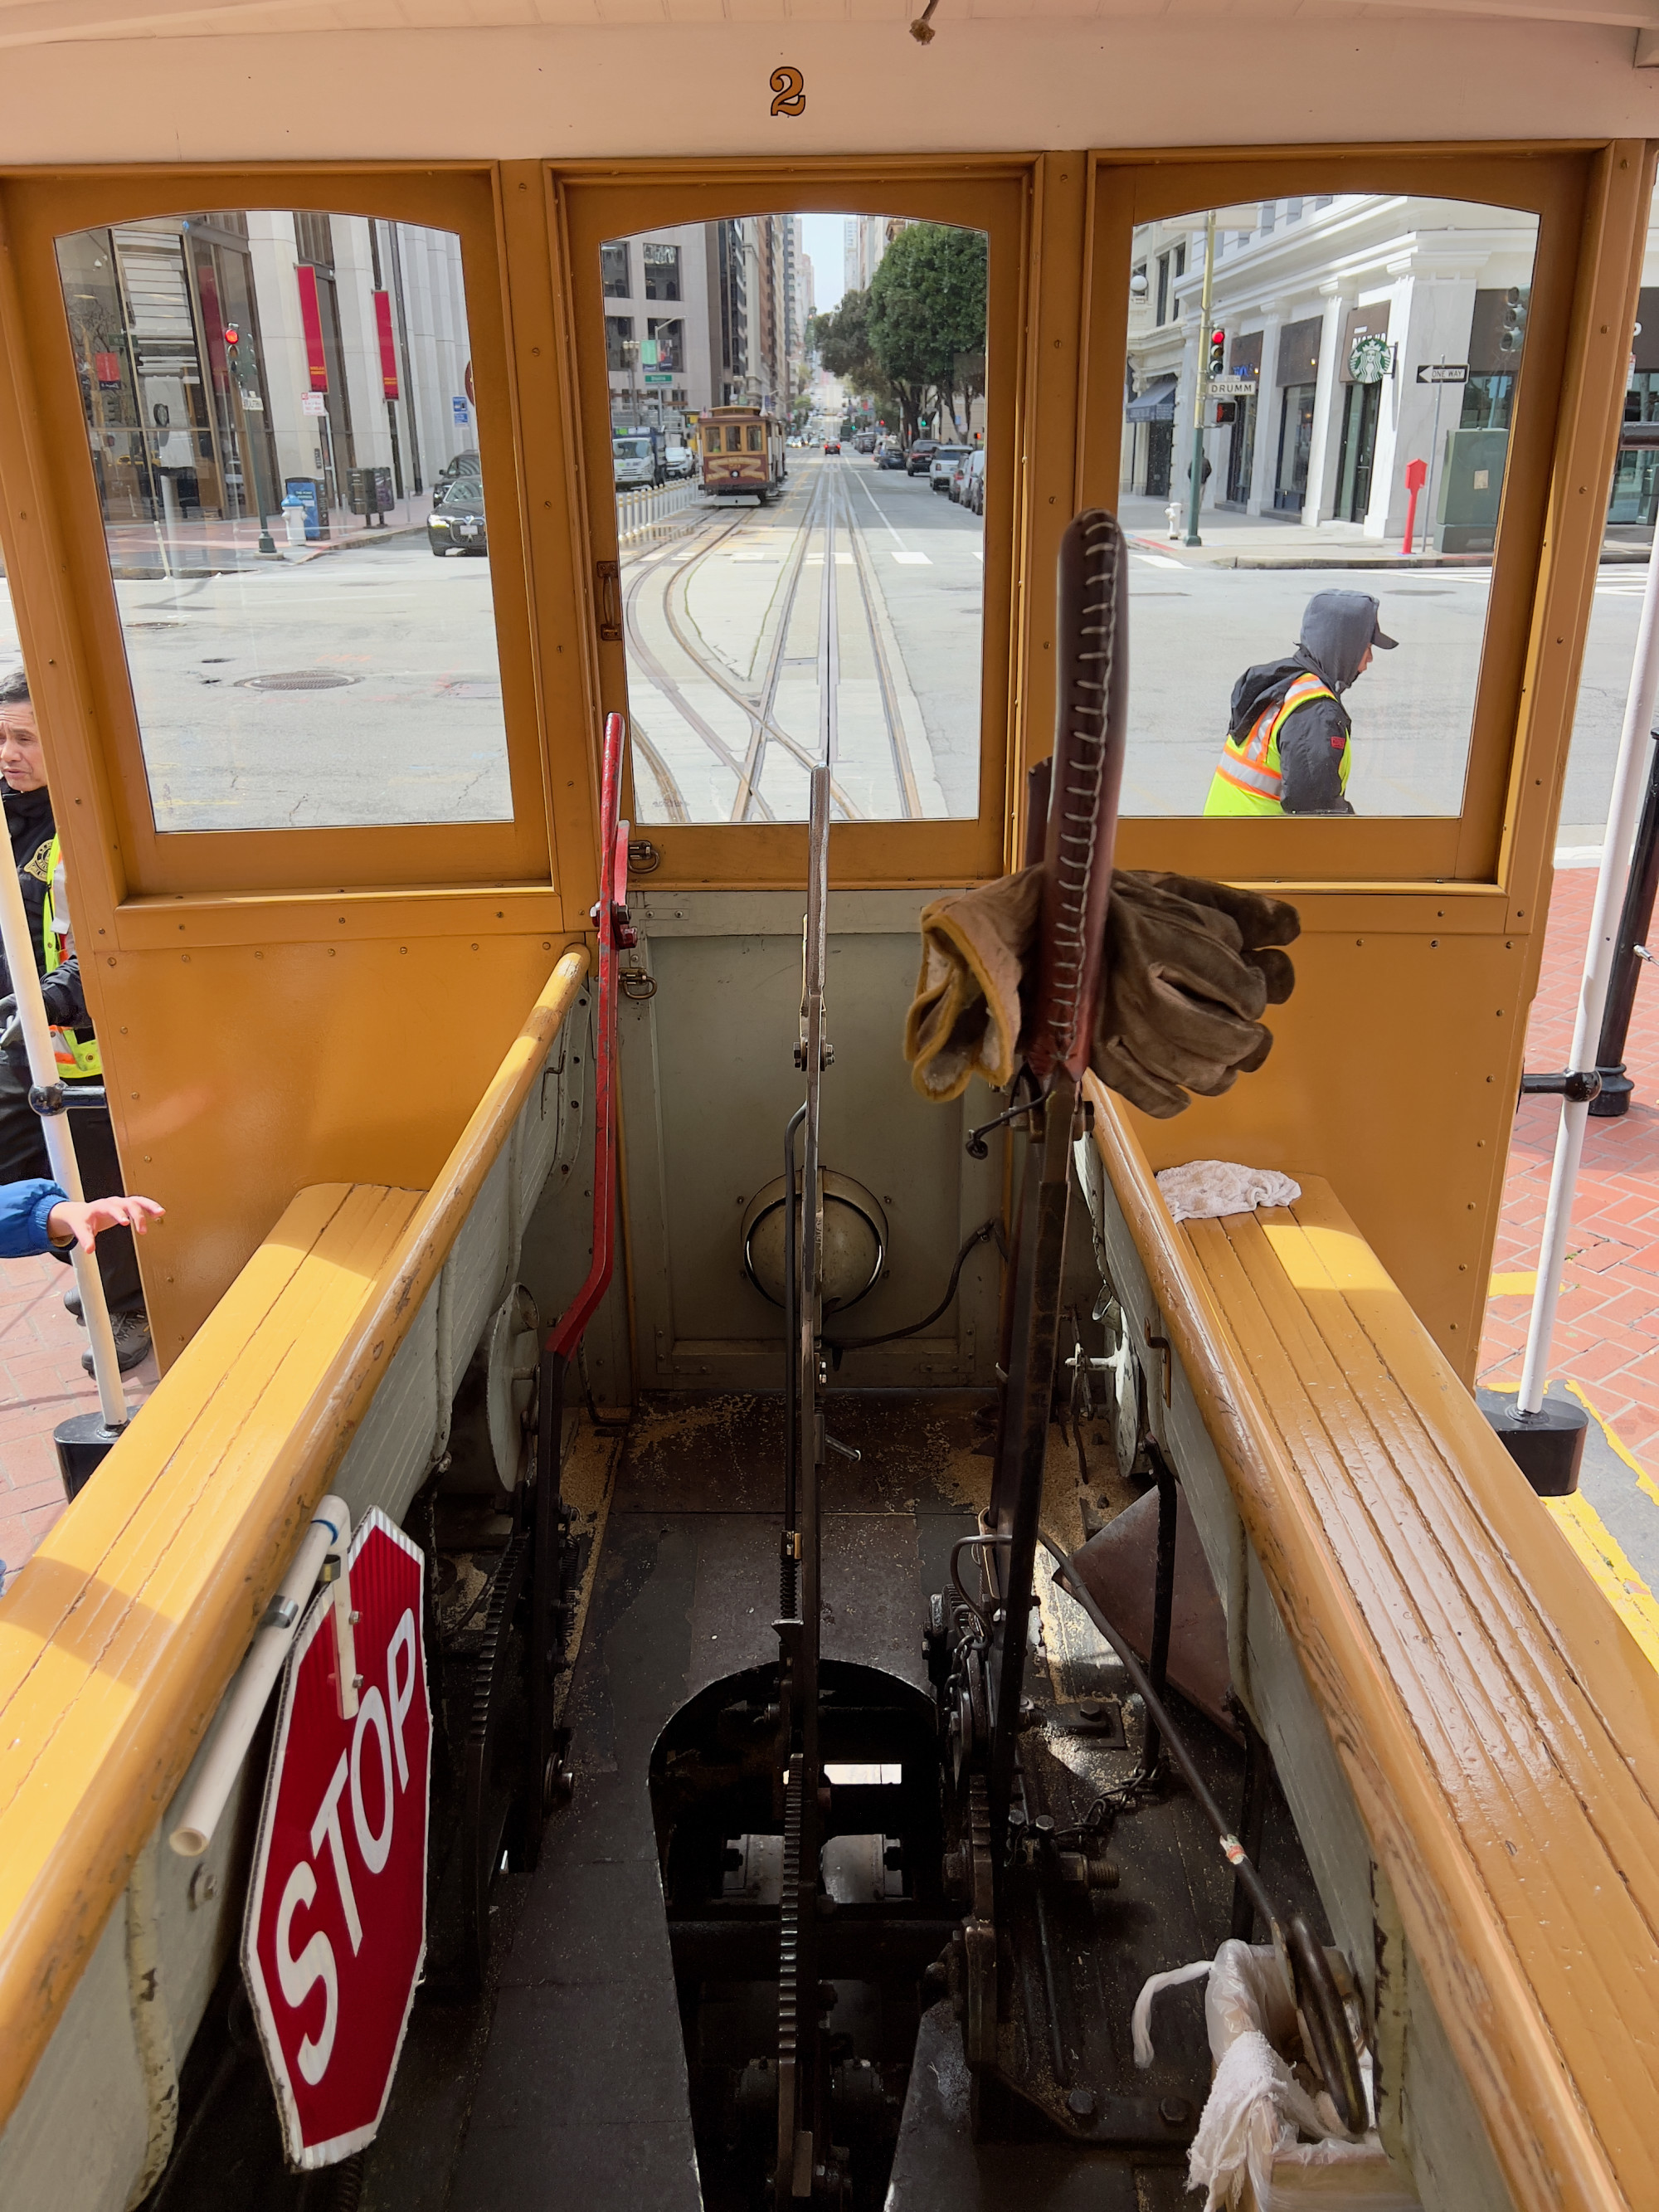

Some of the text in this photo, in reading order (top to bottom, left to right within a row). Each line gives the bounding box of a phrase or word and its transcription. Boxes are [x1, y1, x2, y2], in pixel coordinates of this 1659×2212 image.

[770, 66, 805, 116] 2
[1211, 384, 1252, 392] DRUMM
[275, 1608, 416, 2086] STOP
